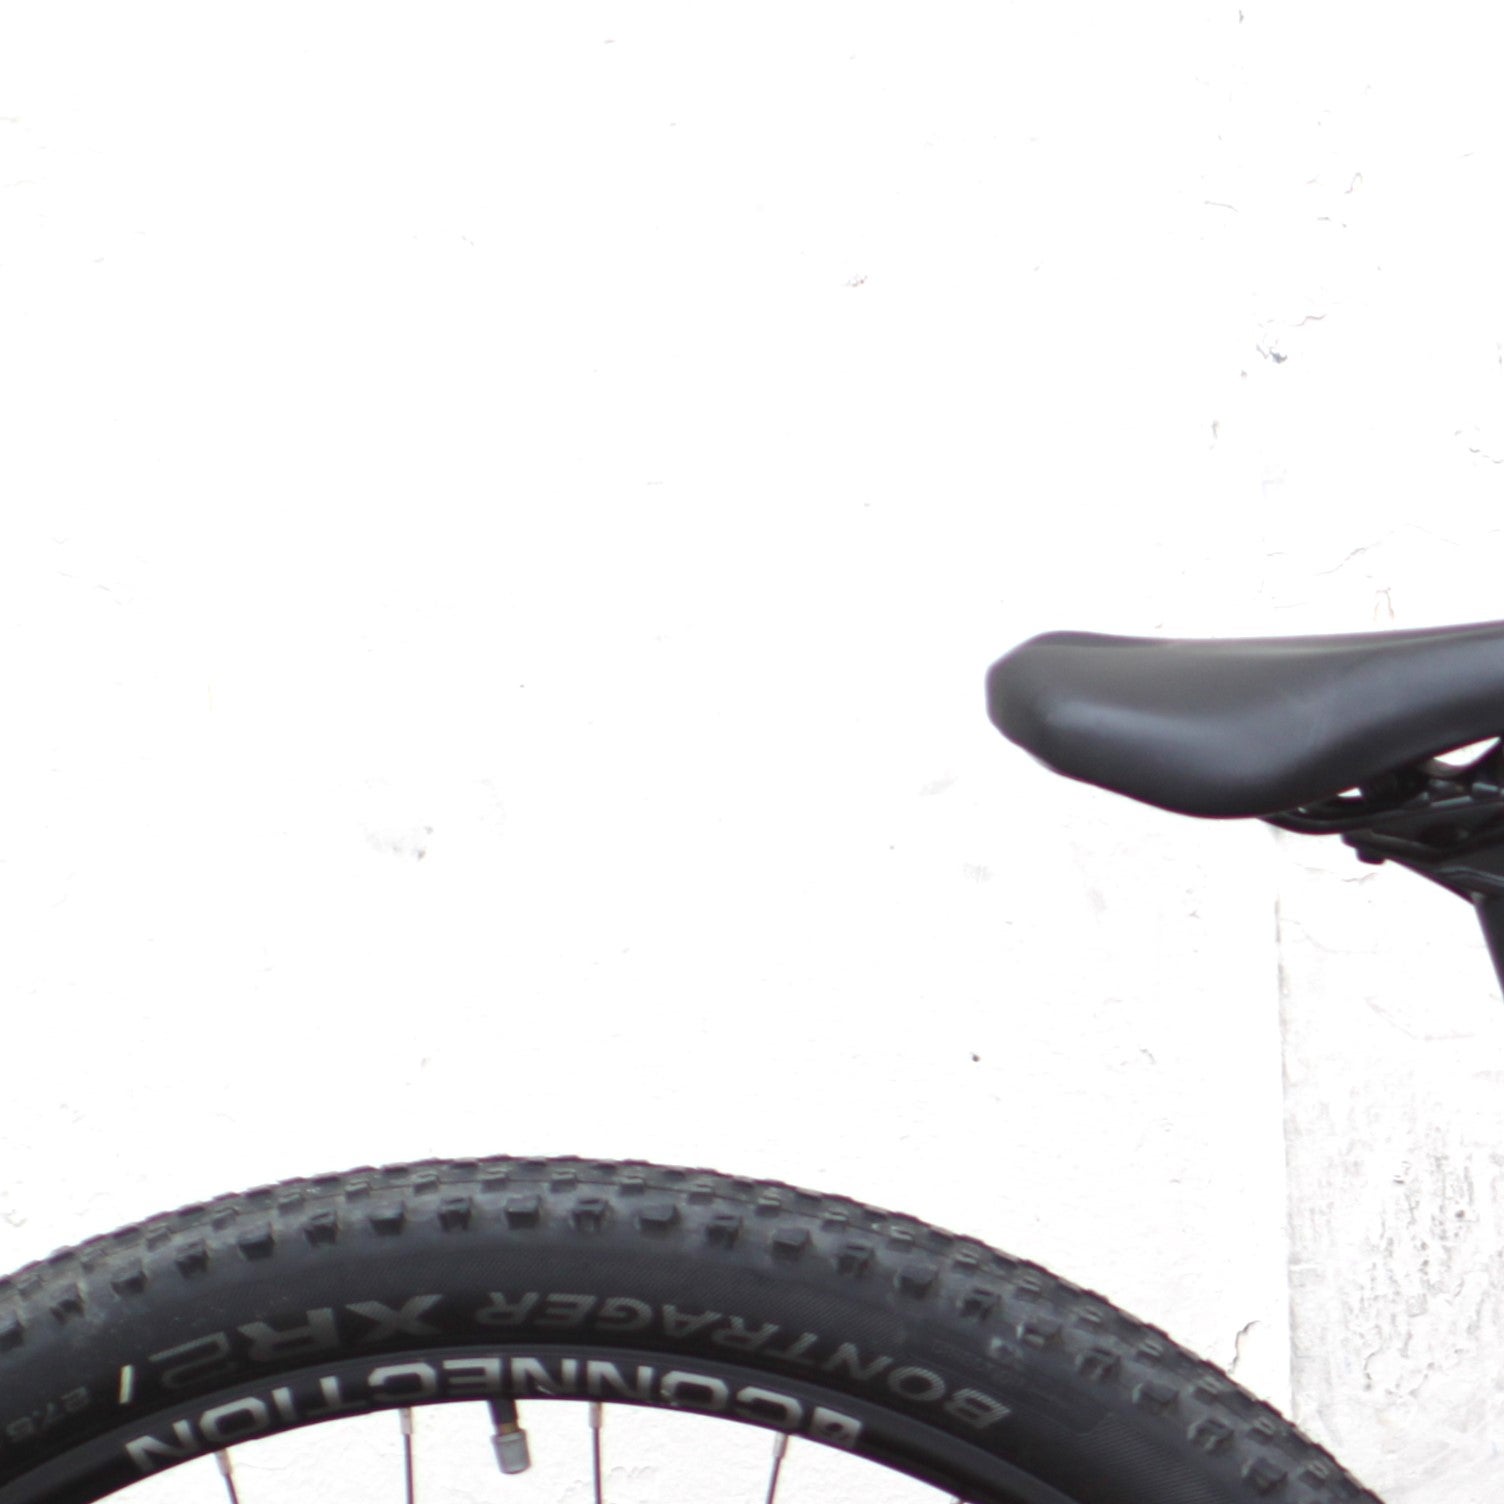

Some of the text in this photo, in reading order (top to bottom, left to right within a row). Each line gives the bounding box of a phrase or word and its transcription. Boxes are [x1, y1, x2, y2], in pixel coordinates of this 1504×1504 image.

[123, 1356, 804, 1472] CONNECTION
[148, 1290, 1012, 1430] BONTRAGER XR2
